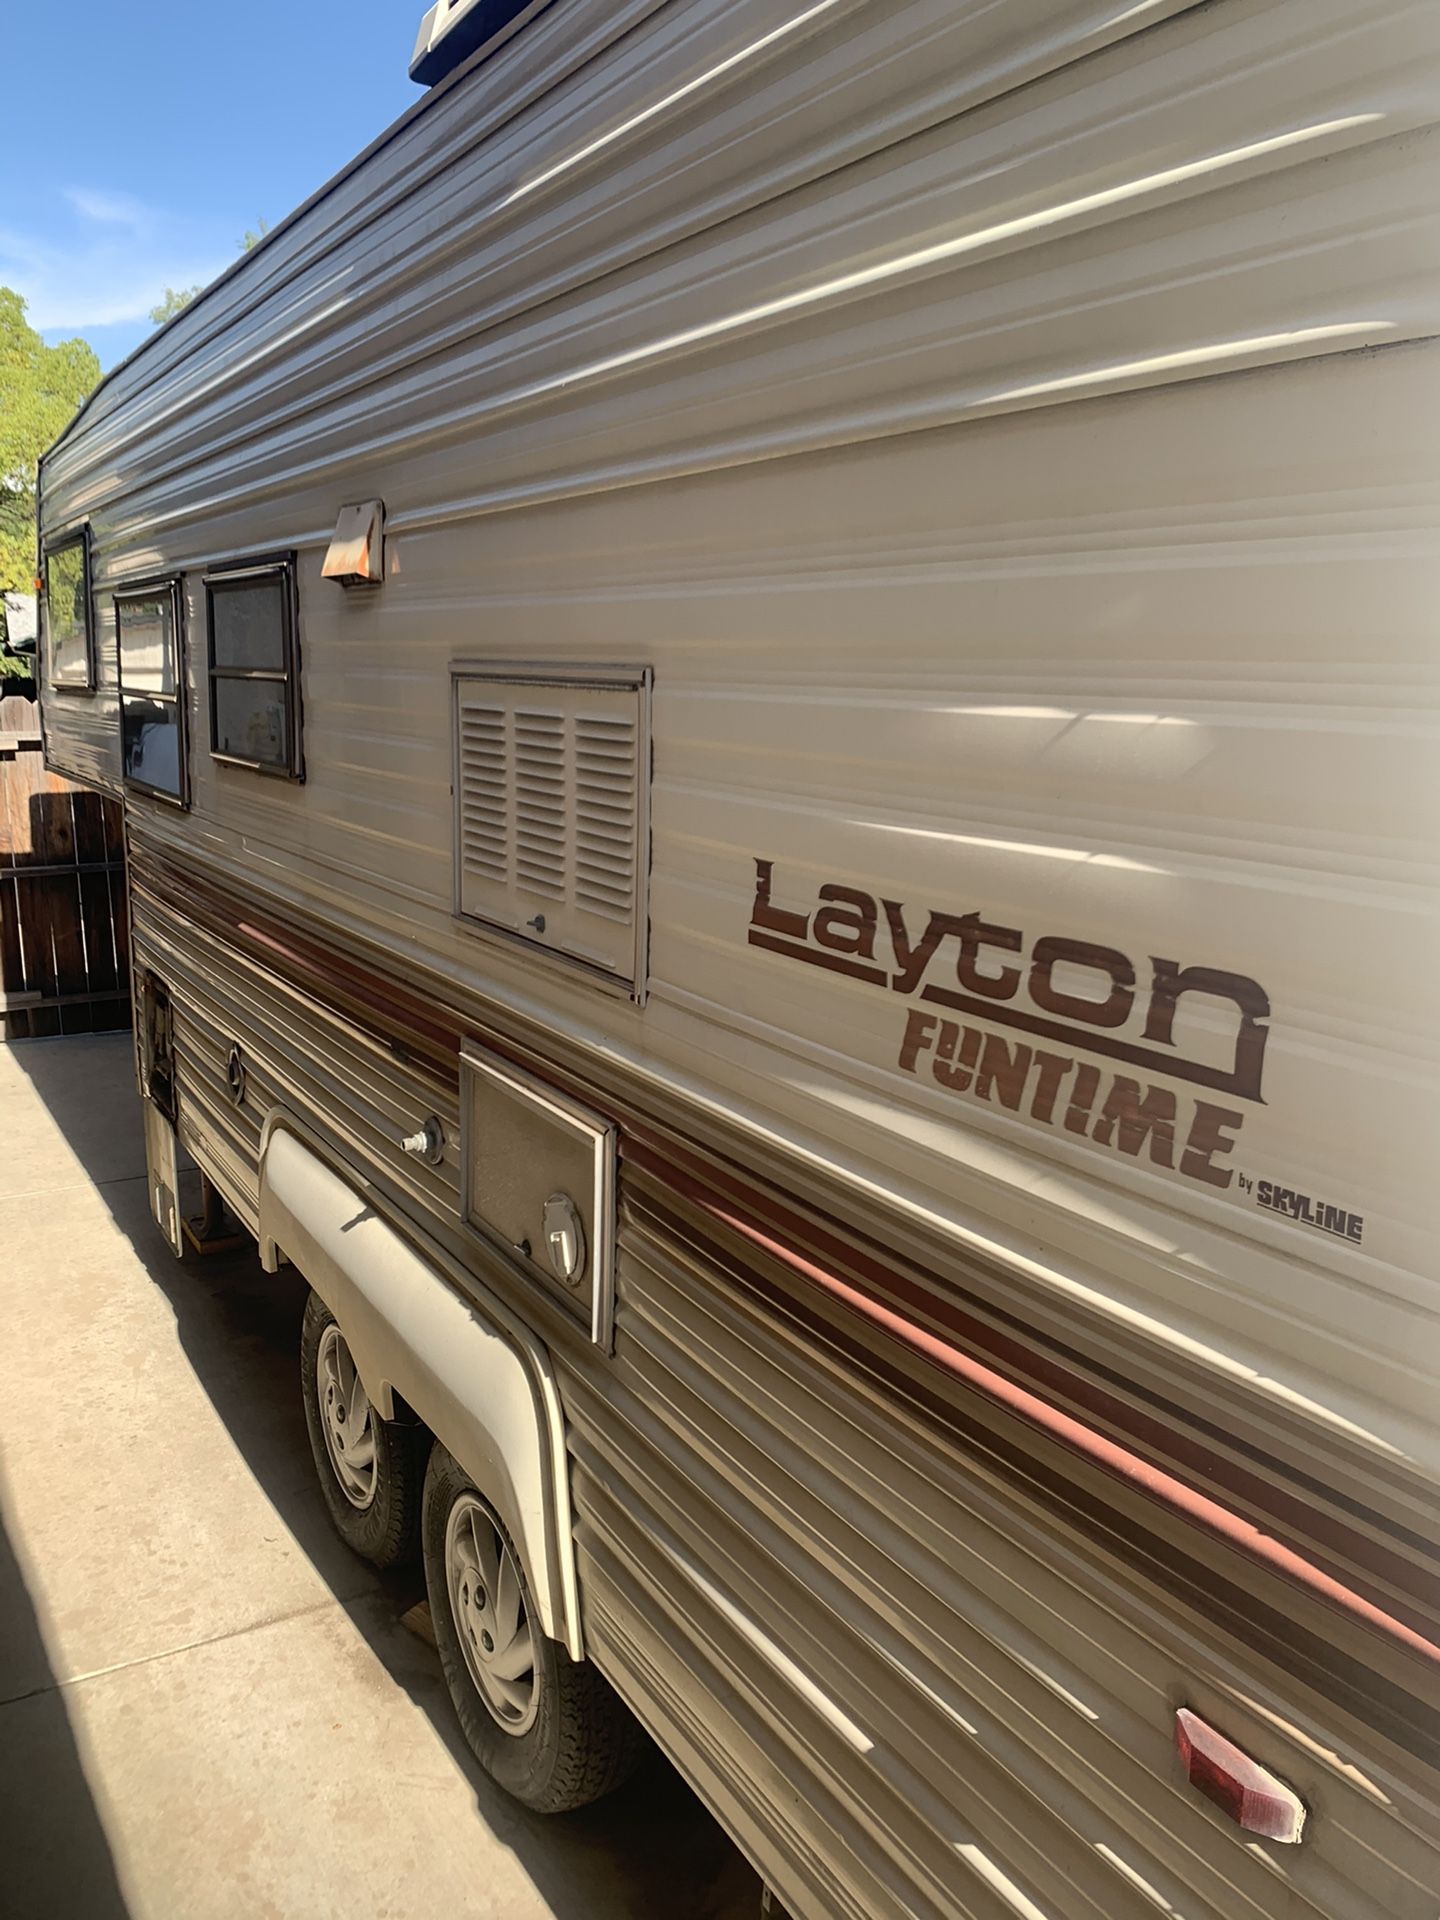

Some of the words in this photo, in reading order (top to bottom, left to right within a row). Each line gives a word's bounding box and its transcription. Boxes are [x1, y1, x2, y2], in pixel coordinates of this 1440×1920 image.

[749, 857, 1272, 1106] Layton
[898, 1007, 1244, 1189] FUNTIME
[1238, 1172, 1253, 1195] by
